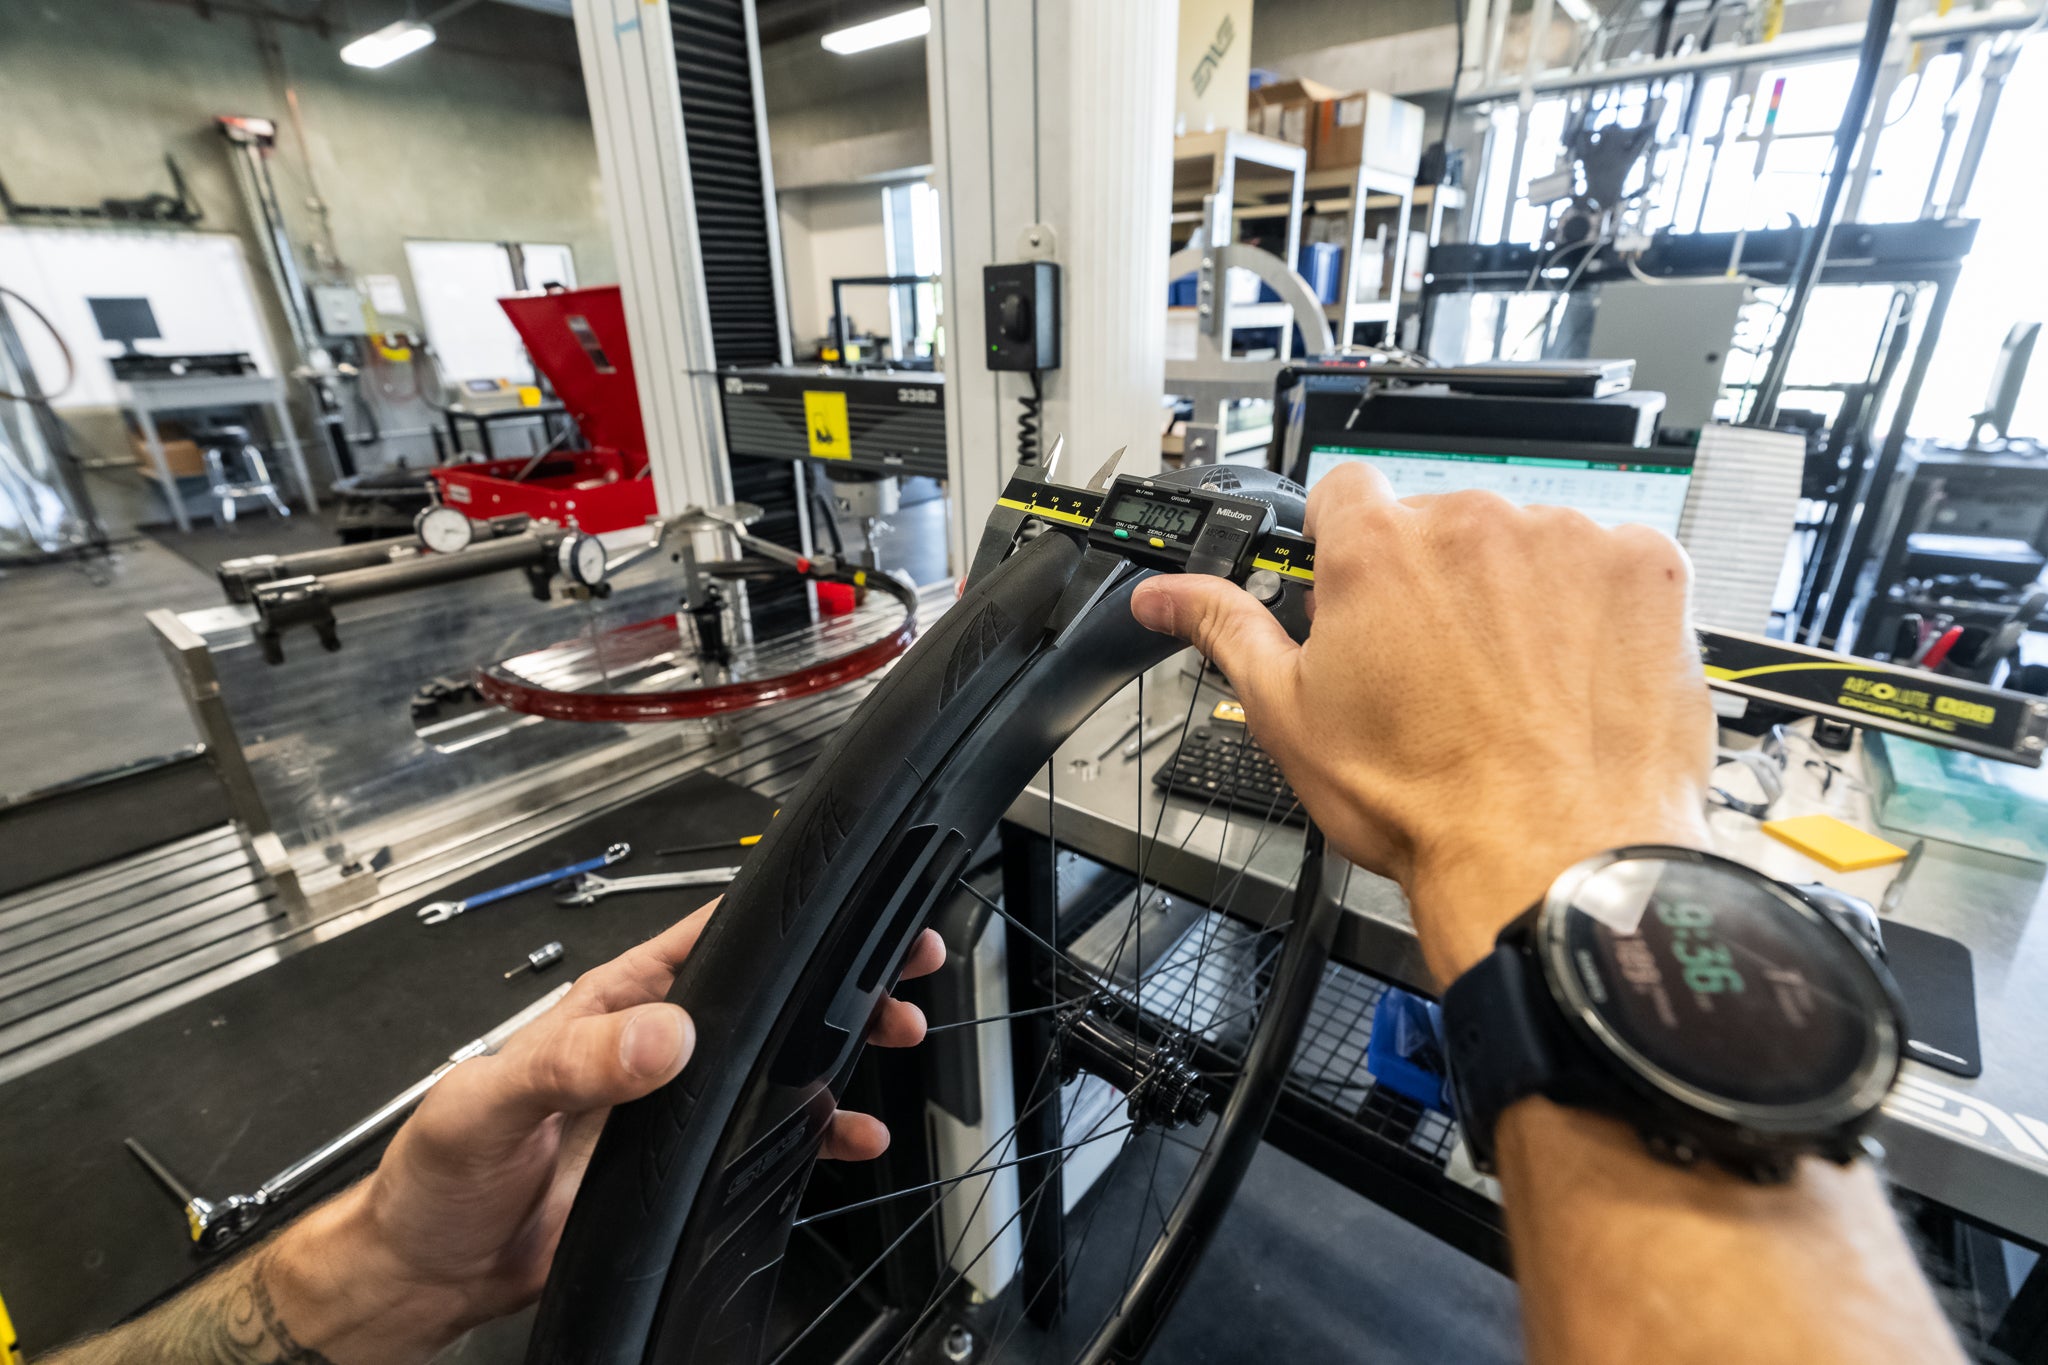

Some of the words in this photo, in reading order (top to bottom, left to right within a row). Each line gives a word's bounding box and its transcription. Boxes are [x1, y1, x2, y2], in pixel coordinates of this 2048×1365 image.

[1171, 495, 1191, 504] ORIGIN
[1216, 507, 1253, 521] Mitutoyo
[1274, 547, 1290, 556] 100
[1651, 899, 1747, 994] 9:36
